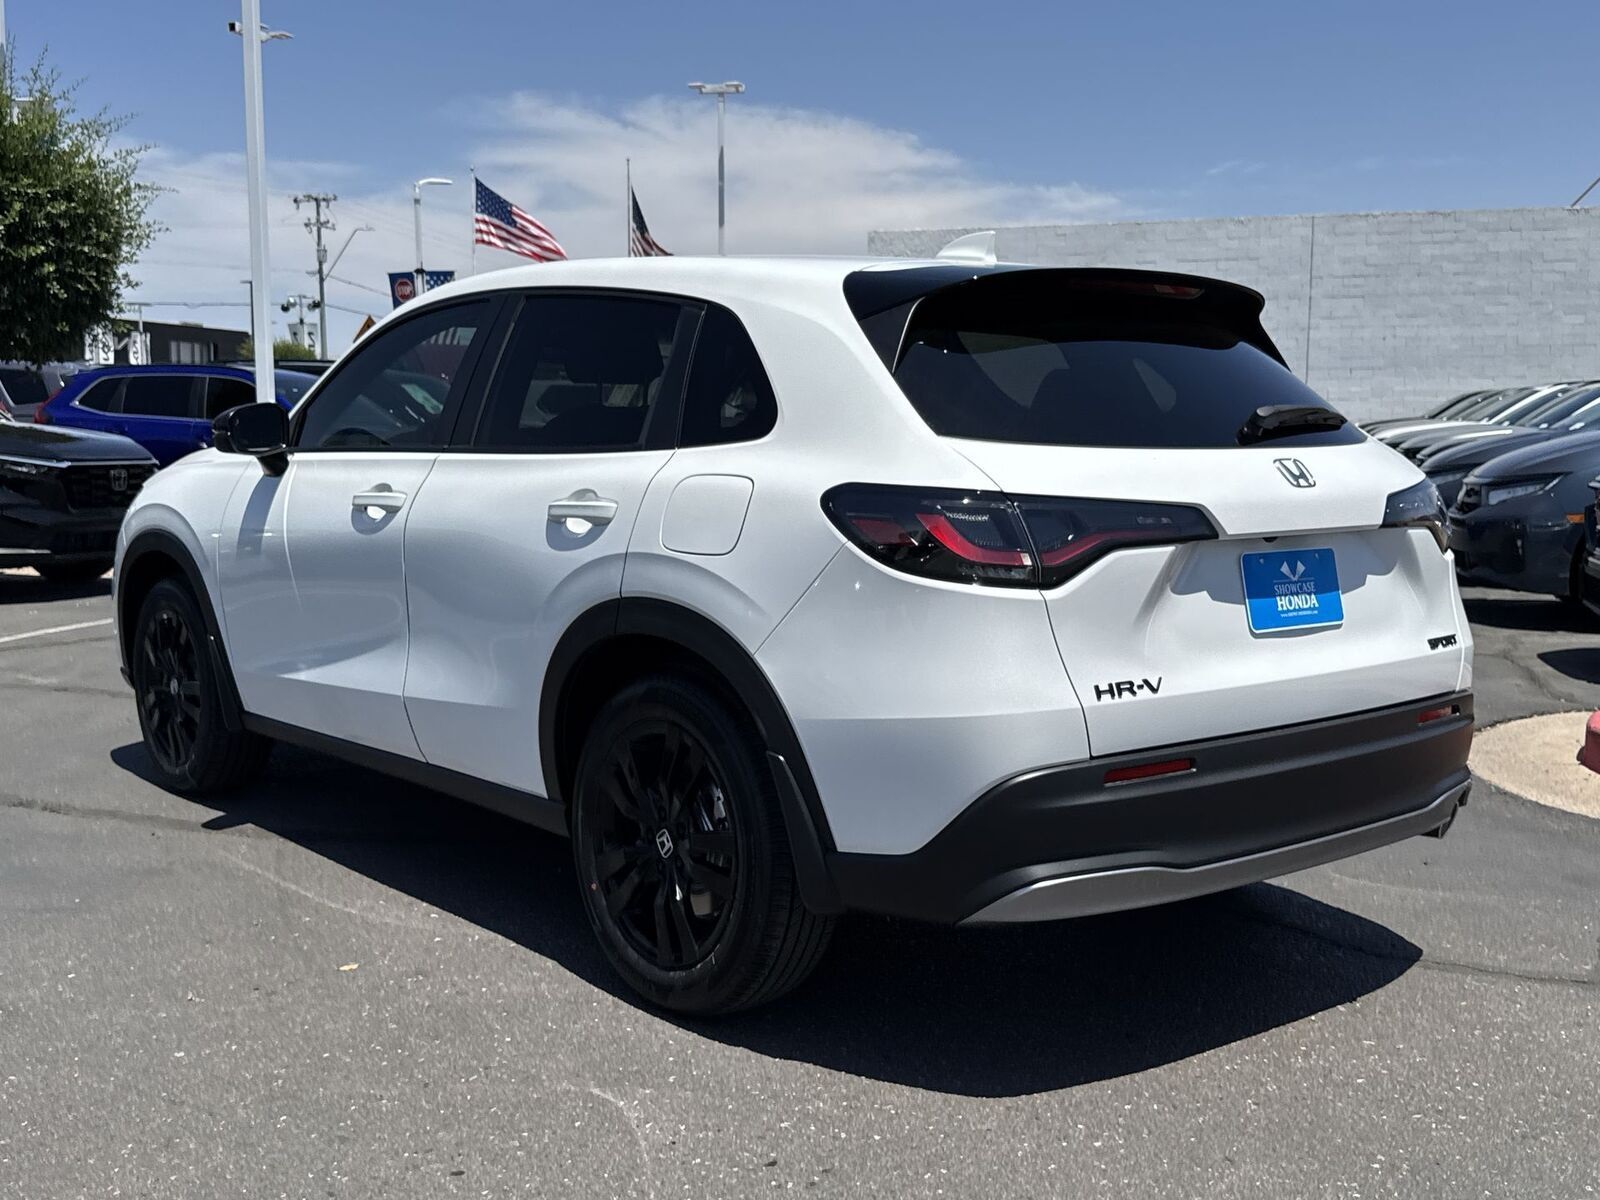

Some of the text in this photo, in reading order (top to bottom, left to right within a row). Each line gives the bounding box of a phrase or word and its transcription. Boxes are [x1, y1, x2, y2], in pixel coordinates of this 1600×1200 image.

[1274, 582, 1316, 595] SHOWCASE
[1276, 593, 1319, 611] HONDA
[1427, 634, 1457, 651] SPORT
[1094, 676, 1162, 702] HR-V
